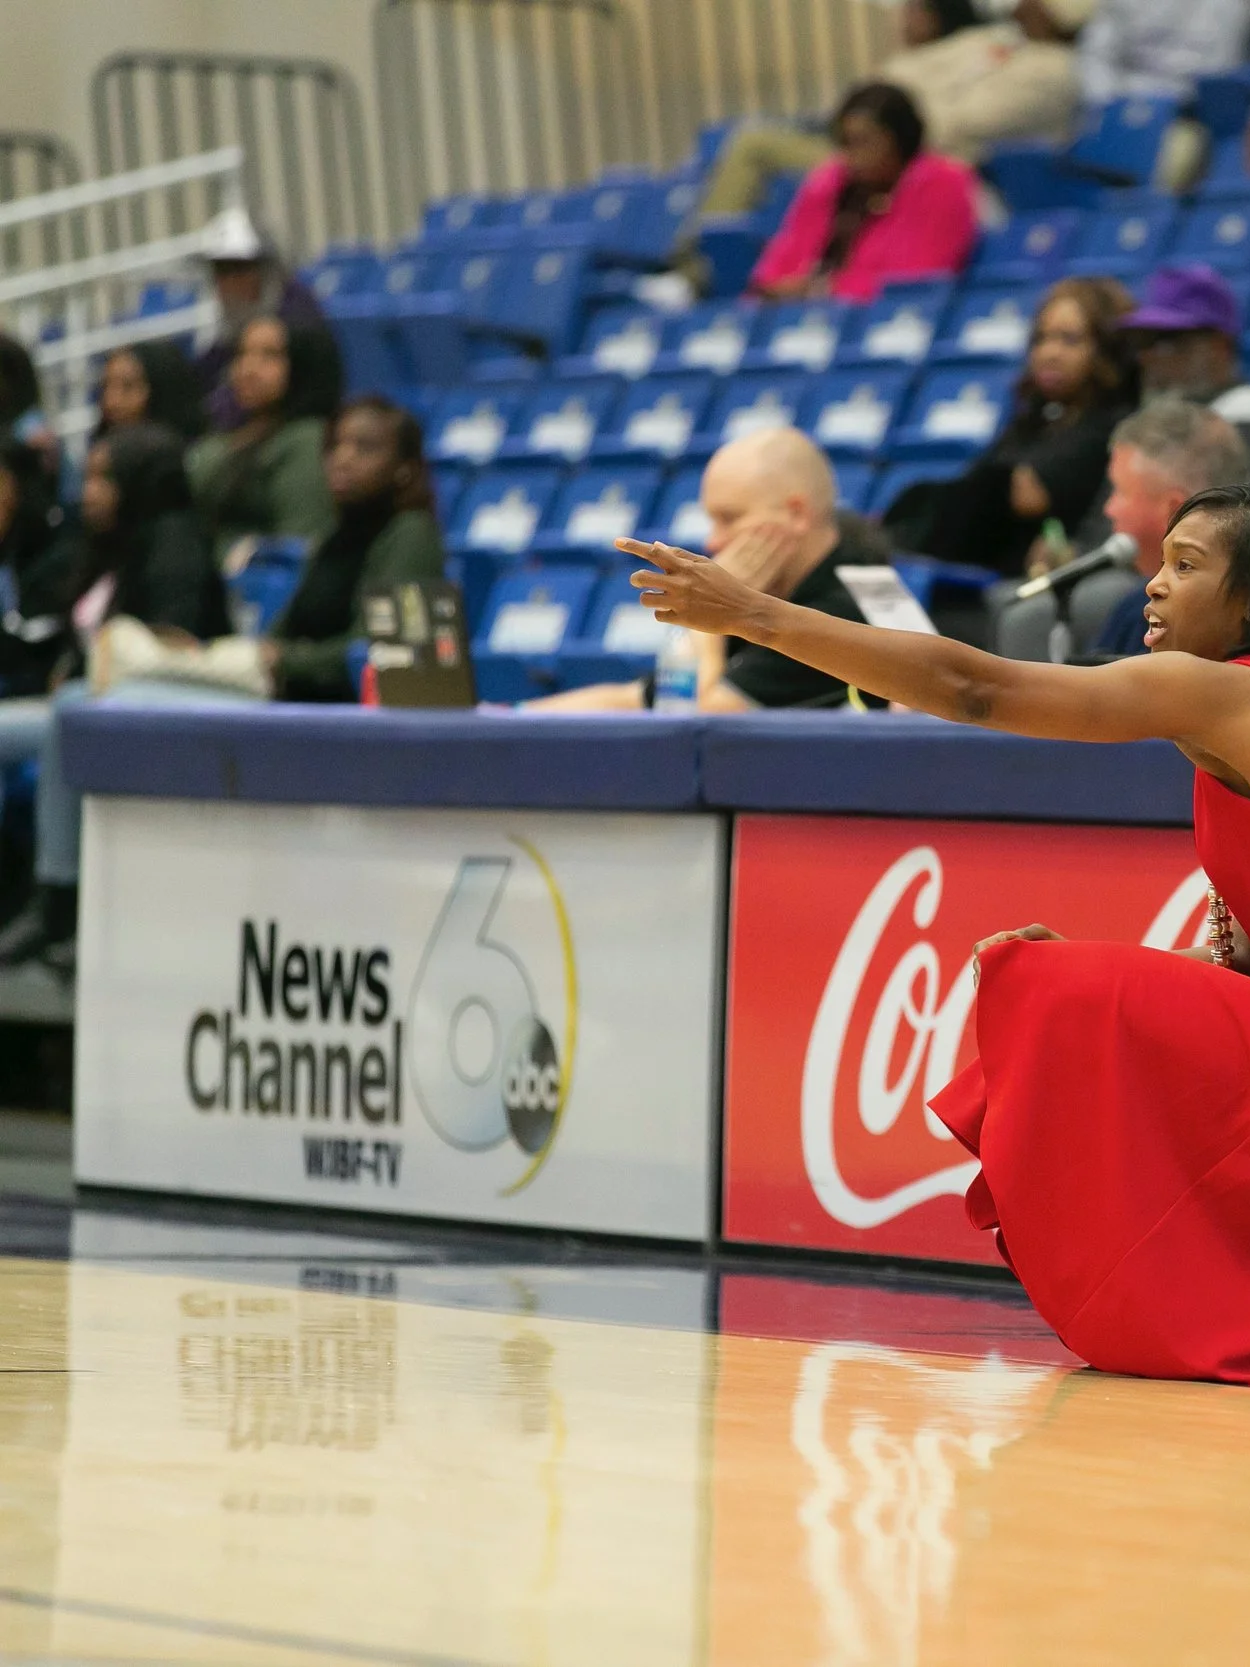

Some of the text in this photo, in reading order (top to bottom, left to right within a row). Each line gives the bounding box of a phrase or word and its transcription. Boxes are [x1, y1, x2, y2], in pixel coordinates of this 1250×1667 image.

[238, 917, 391, 1027] News
[410, 855, 540, 1153] 6
[185, 1010, 404, 1126] Channel
[506, 1056, 560, 1113] abc
